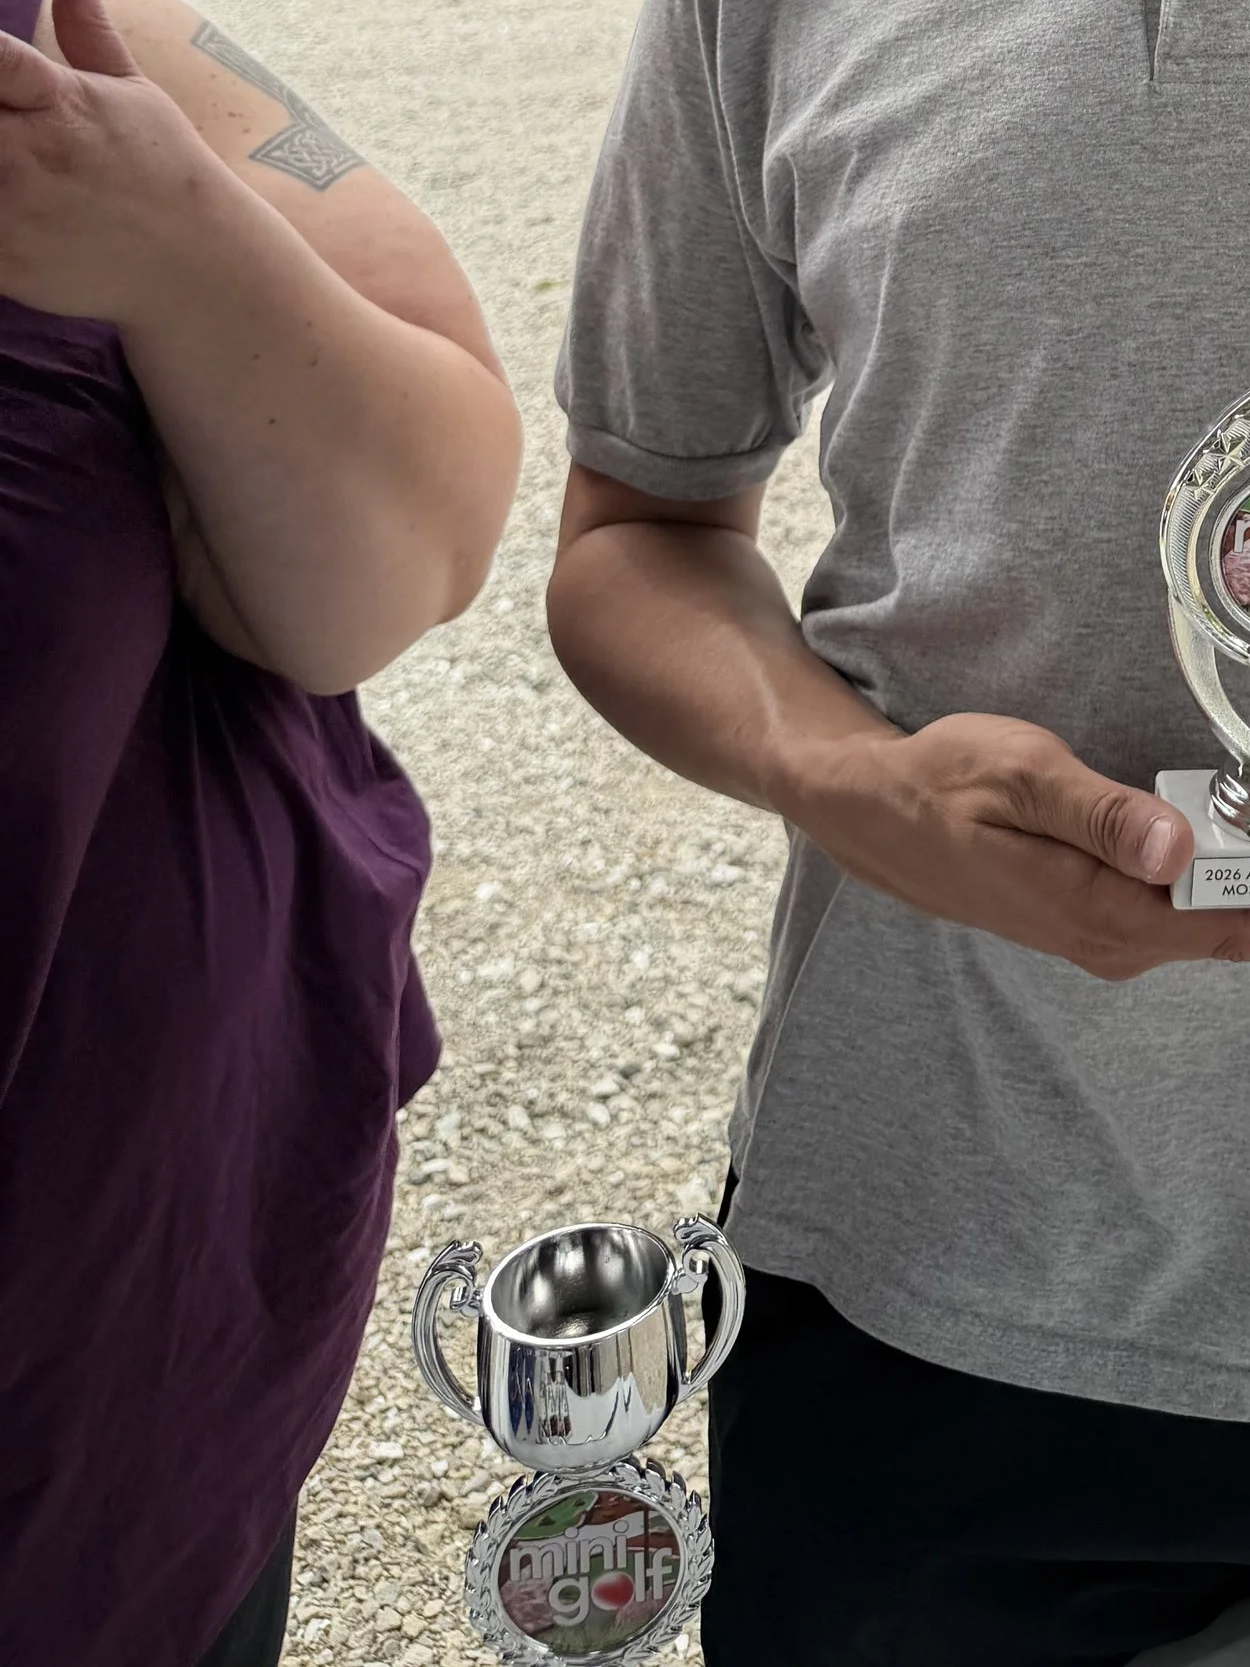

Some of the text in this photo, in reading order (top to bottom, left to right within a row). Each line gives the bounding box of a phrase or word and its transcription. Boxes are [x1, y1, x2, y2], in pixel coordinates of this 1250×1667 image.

[1204, 868, 1242, 882] 2026
[509, 1520, 630, 1582] mini
[548, 1548, 674, 1627] golf
